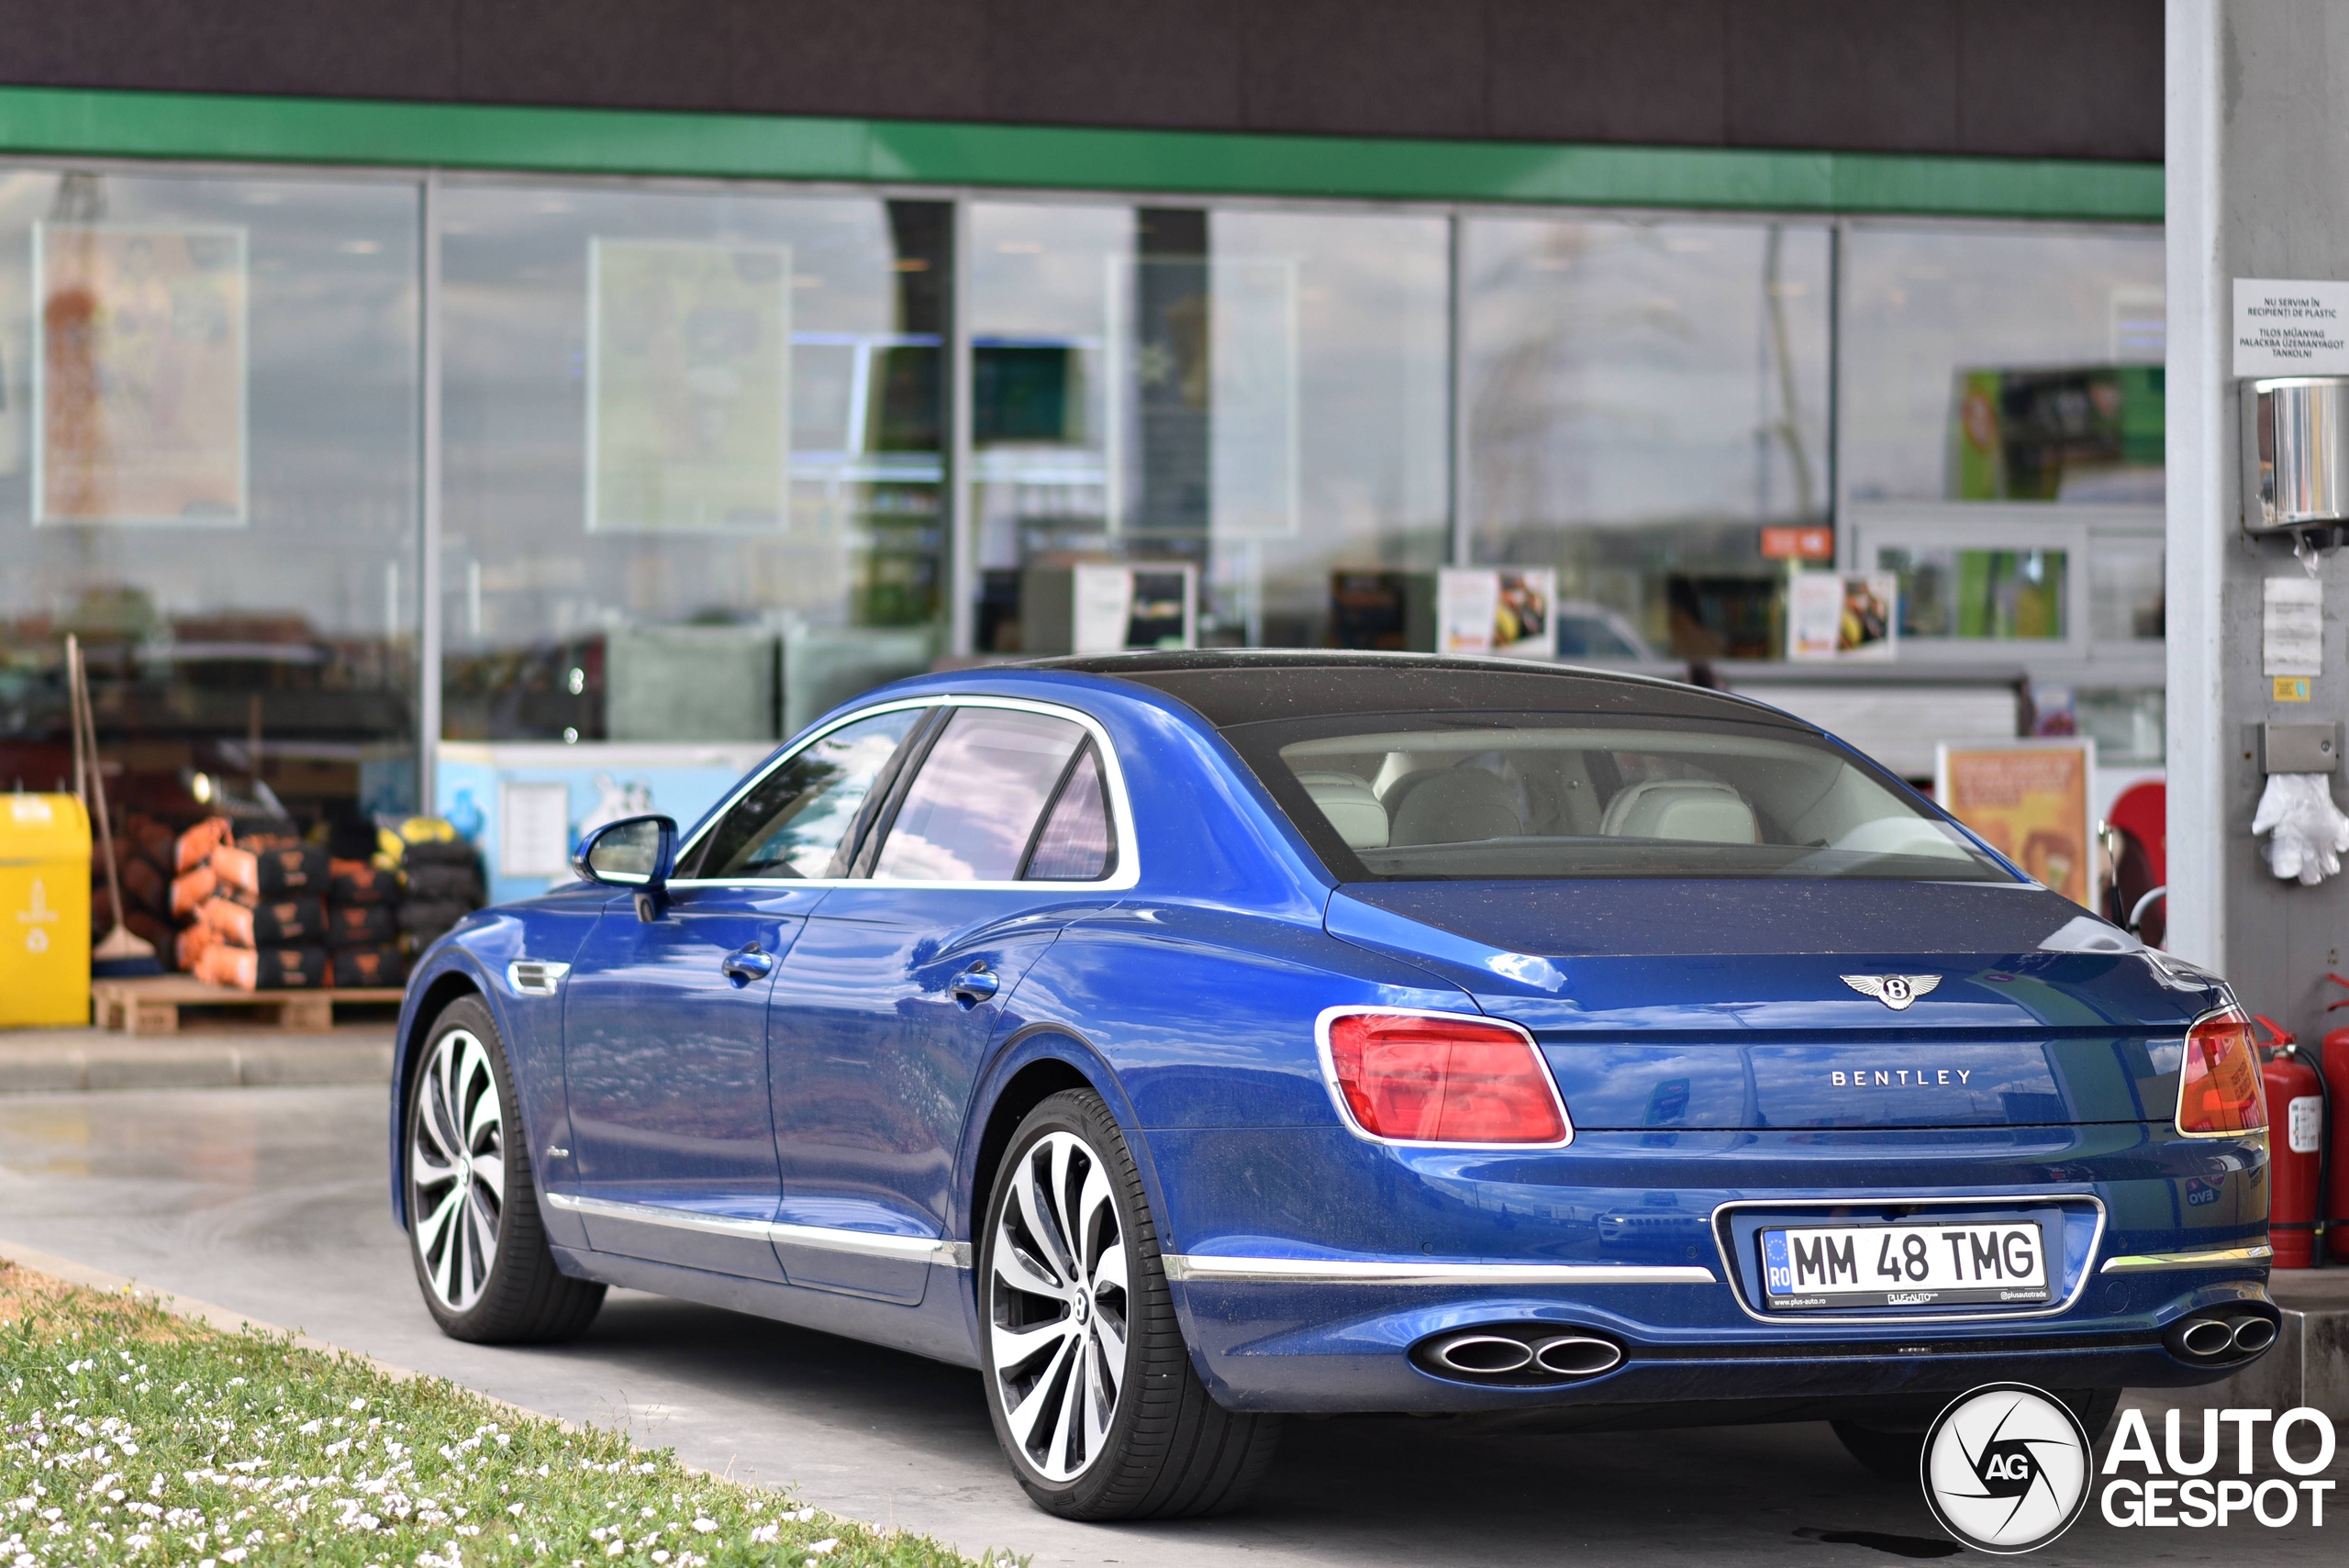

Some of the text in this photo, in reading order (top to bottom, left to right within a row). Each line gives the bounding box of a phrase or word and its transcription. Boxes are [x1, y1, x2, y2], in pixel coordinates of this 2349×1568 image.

[2265, 296, 2320, 307] NU SERVIM ÎN
[2293, 308, 2302, 317] DE
[2305, 308, 2337, 318] PLASTIC
[2259, 328, 2281, 338] TILOS
[2240, 339, 2281, 348] PALACKBA
[2272, 350, 2312, 359] TANKOLNI
[1887, 981, 1907, 999] B
[1831, 1070, 1971, 1086] BENTLEY
[1793, 1230, 2035, 1285] MM 48 TMG
[1771, 1265, 1791, 1286] RO
[1774, 1298, 1827, 1307] www.plus-auto.ro
